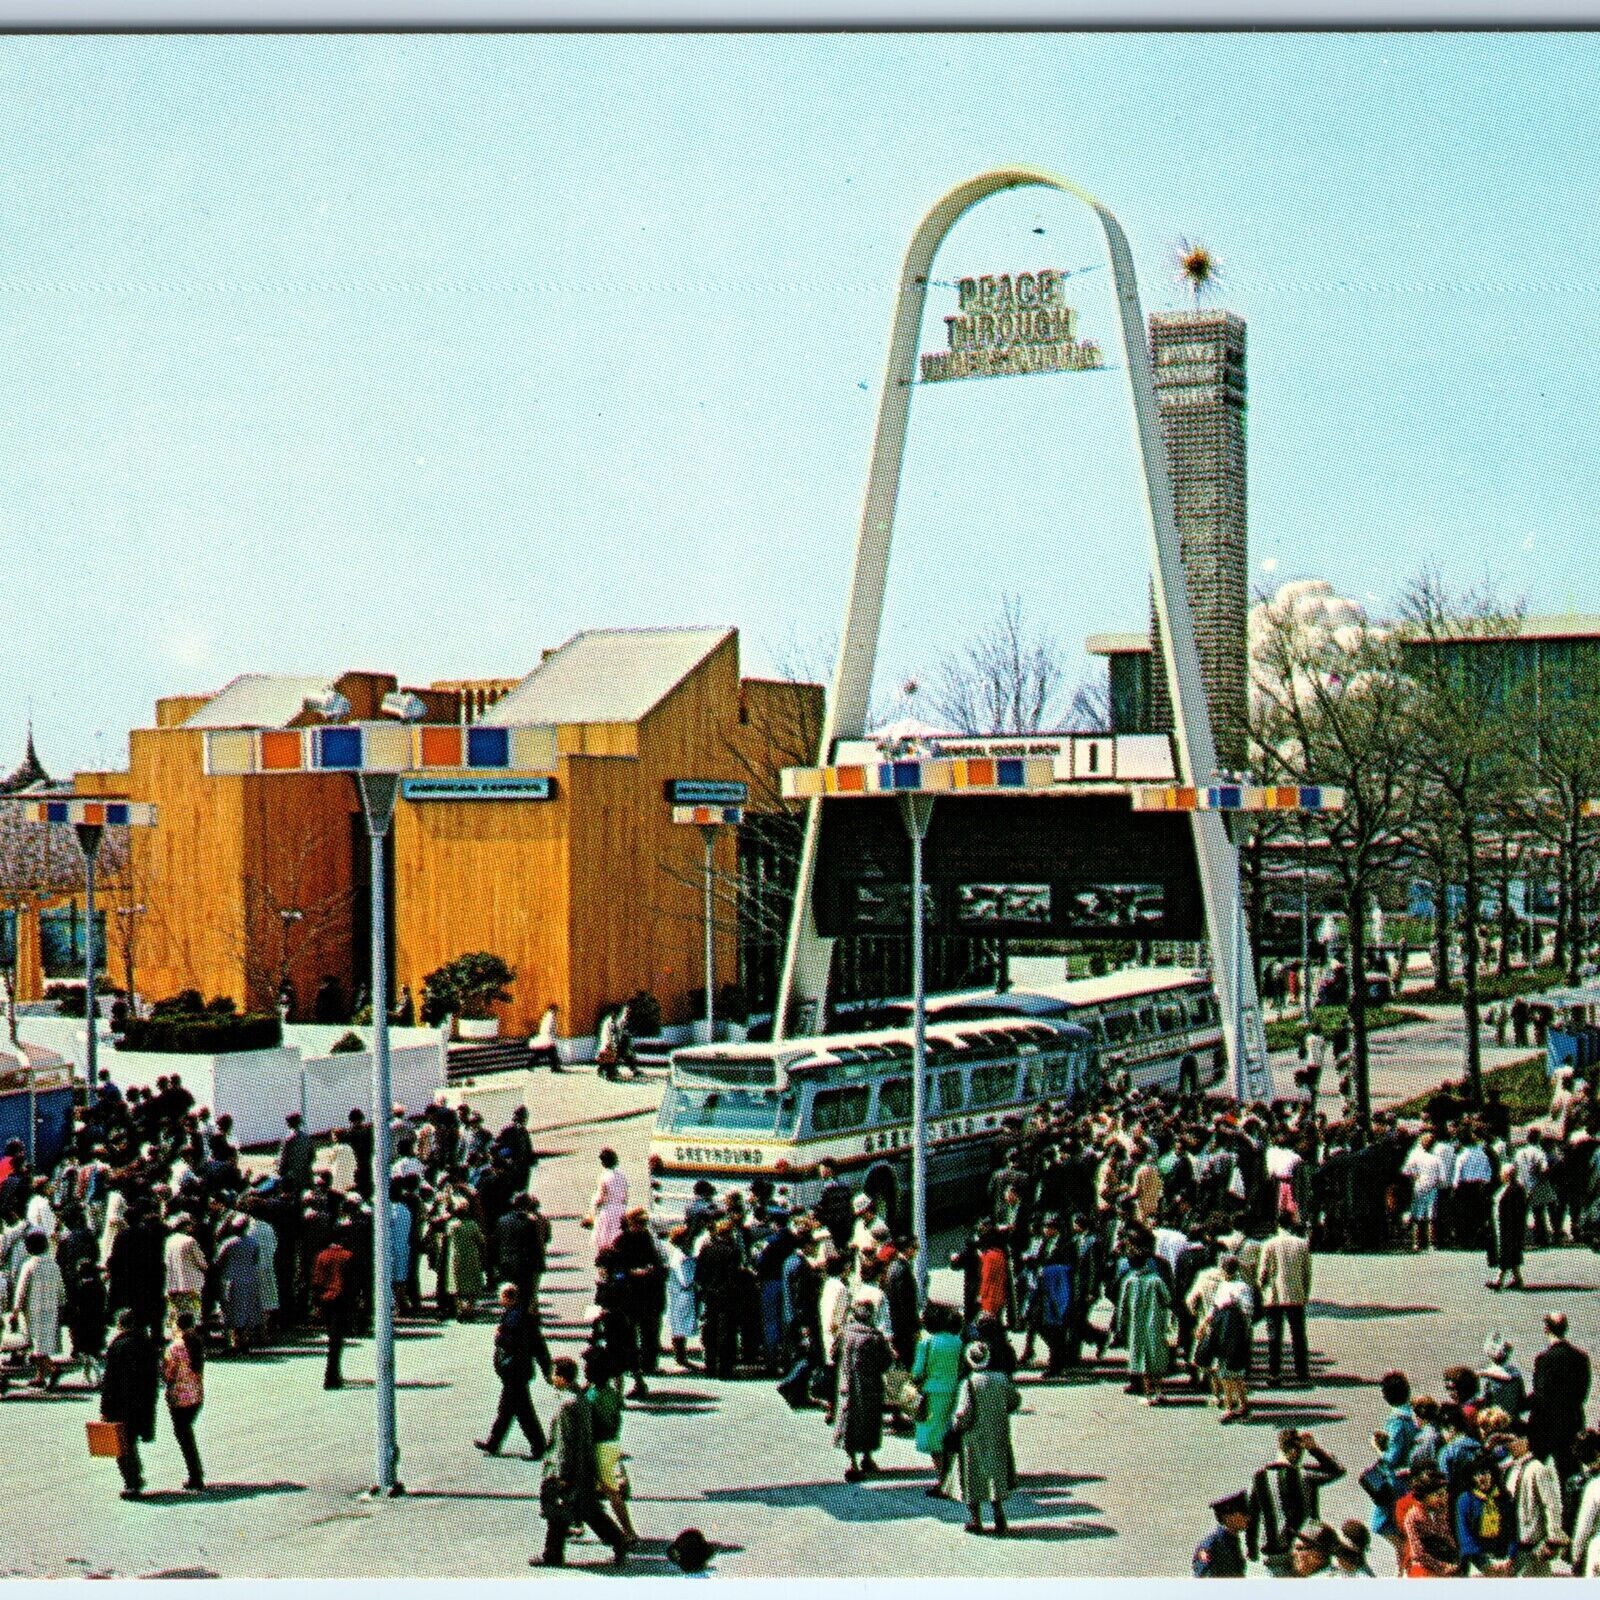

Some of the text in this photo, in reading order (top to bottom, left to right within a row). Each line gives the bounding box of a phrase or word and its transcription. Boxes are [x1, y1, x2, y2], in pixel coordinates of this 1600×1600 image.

[957, 268, 1063, 311] PEACE
[944, 307, 1074, 351] THROUGH
[676, 1147, 763, 1164] GREYHOUND
